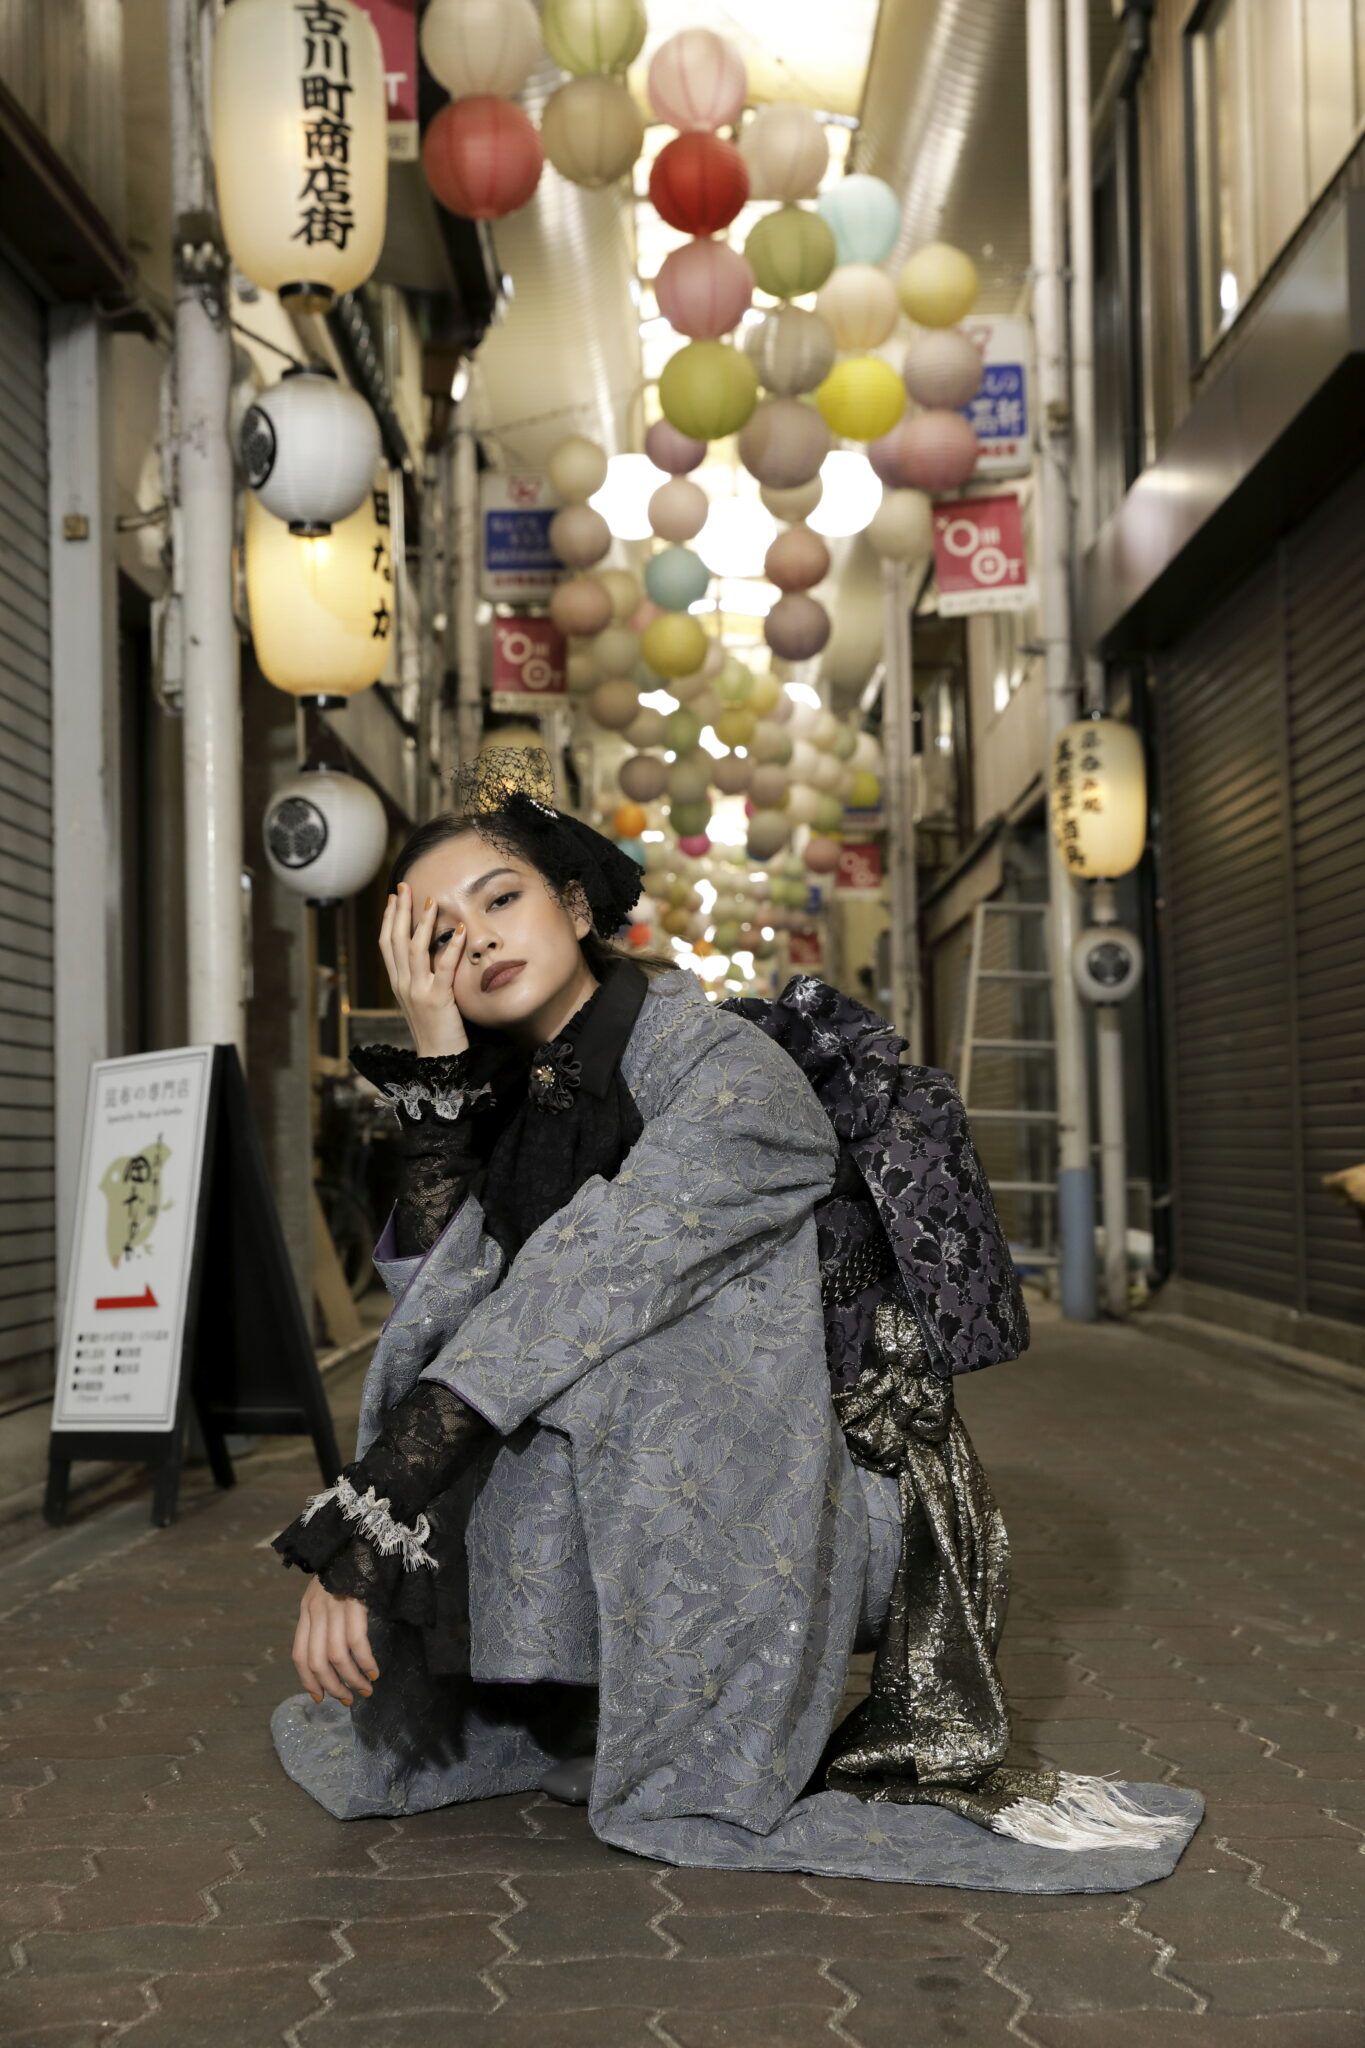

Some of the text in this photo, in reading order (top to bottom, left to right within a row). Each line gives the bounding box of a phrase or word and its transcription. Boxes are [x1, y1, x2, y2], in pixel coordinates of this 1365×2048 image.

[291, 0, 354, 252] 古川町商店街
